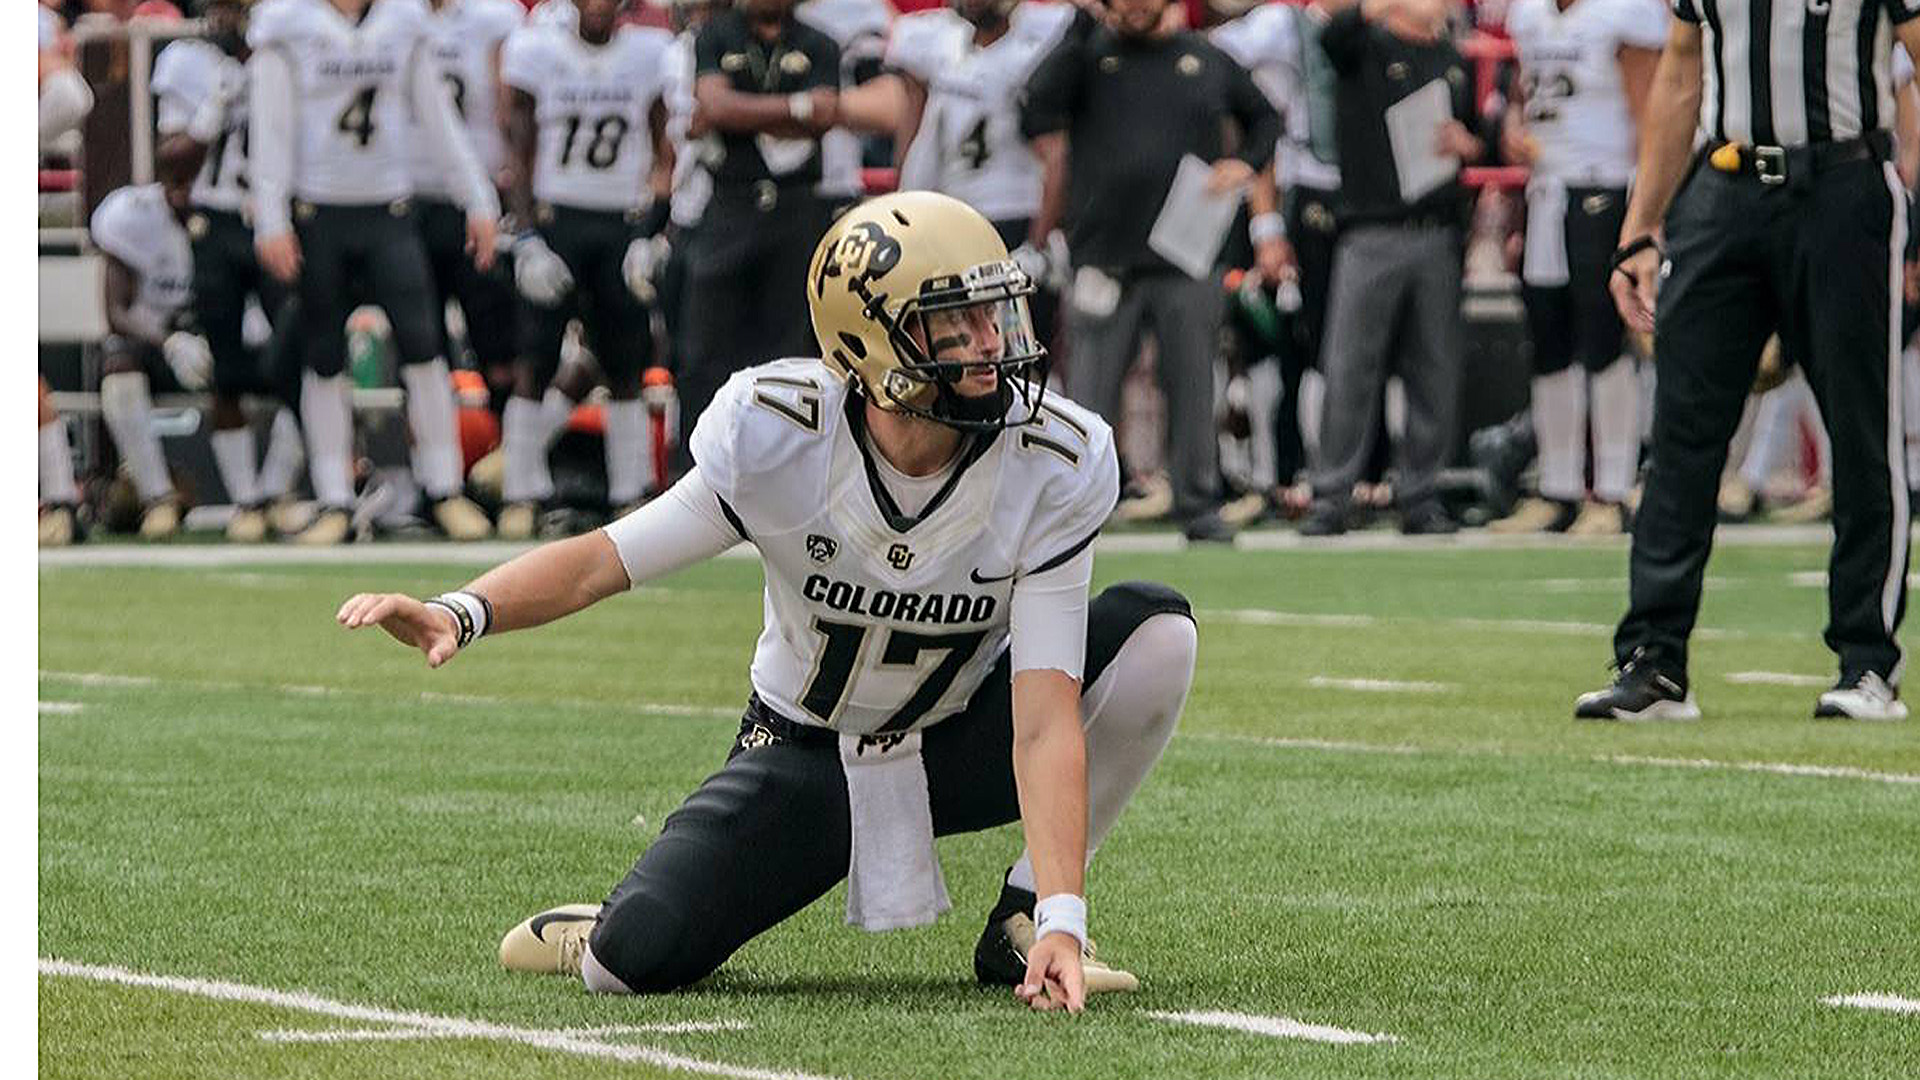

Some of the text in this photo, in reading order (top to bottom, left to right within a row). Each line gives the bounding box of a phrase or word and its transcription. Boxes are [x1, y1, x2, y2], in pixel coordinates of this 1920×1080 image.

[337, 84, 378, 147] 4
[561, 114, 628, 169] 18
[960, 114, 992, 170] 4
[753, 376, 824, 434] 17
[886, 543, 916, 571] CU
[803, 573, 997, 625] COLORADO
[796, 615, 993, 734] 17
